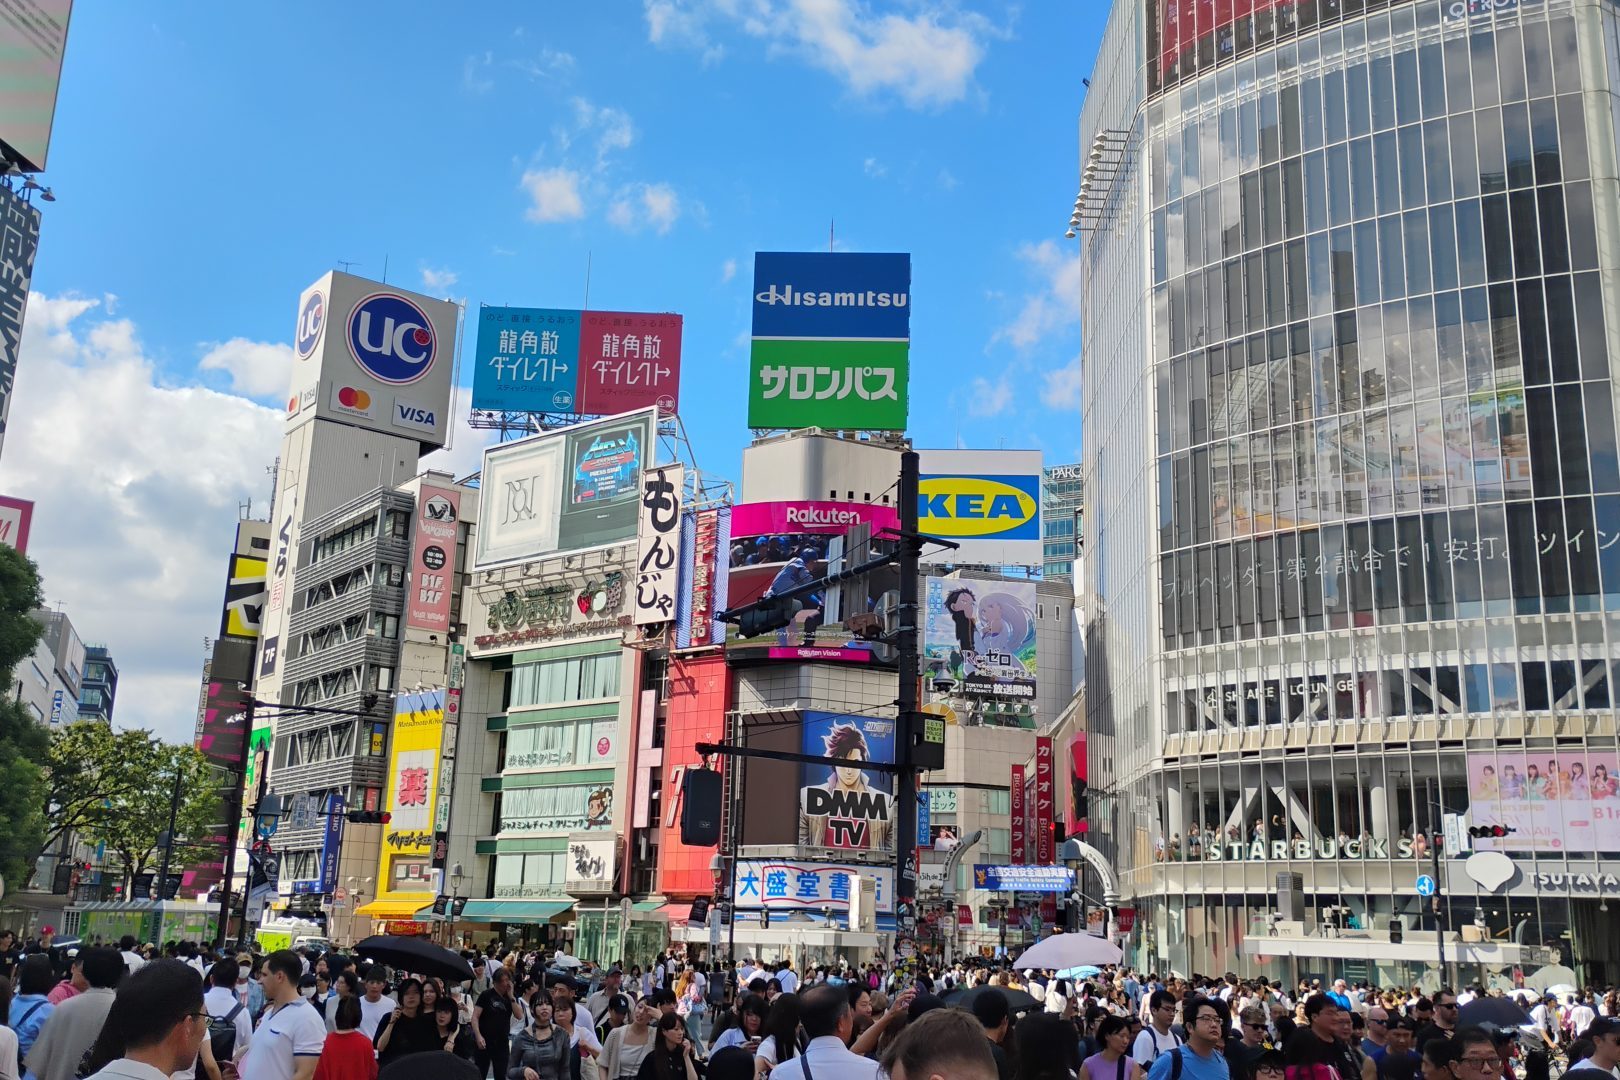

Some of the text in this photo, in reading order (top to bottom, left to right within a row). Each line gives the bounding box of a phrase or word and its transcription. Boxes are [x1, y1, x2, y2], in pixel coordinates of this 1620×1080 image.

[756, 284, 906, 307] Hisamitsu
[359, 310, 427, 364] UC
[499, 329, 559, 356] 龍角散
[602, 333, 662, 359] 龍角散
[489, 357, 569, 382] ダイレクト
[592, 361, 671, 386] ダイレクト
[759, 365, 898, 401] サロンパス
[338, 406, 369, 417] mastercard
[398, 404, 436, 426] VISA
[786, 506, 861, 525] Rakuten
[917, 493, 1026, 519] KEA
[637, 470, 679, 618] もんじゃ
[797, 649, 822, 657] Rakuten
[992, 682, 1034, 697] 放送開始
[1225, 686, 1275, 703] SHARE
[399, 767, 429, 808] 薬
[1037, 745, 1051, 810] カラオケ
[805, 787, 888, 821] DMM
[829, 819, 866, 846] TV
[1013, 816, 1024, 866] カラオ
[1209, 838, 1414, 861] STARBUCKS
[1527, 871, 1618, 886] TSUTAYA
